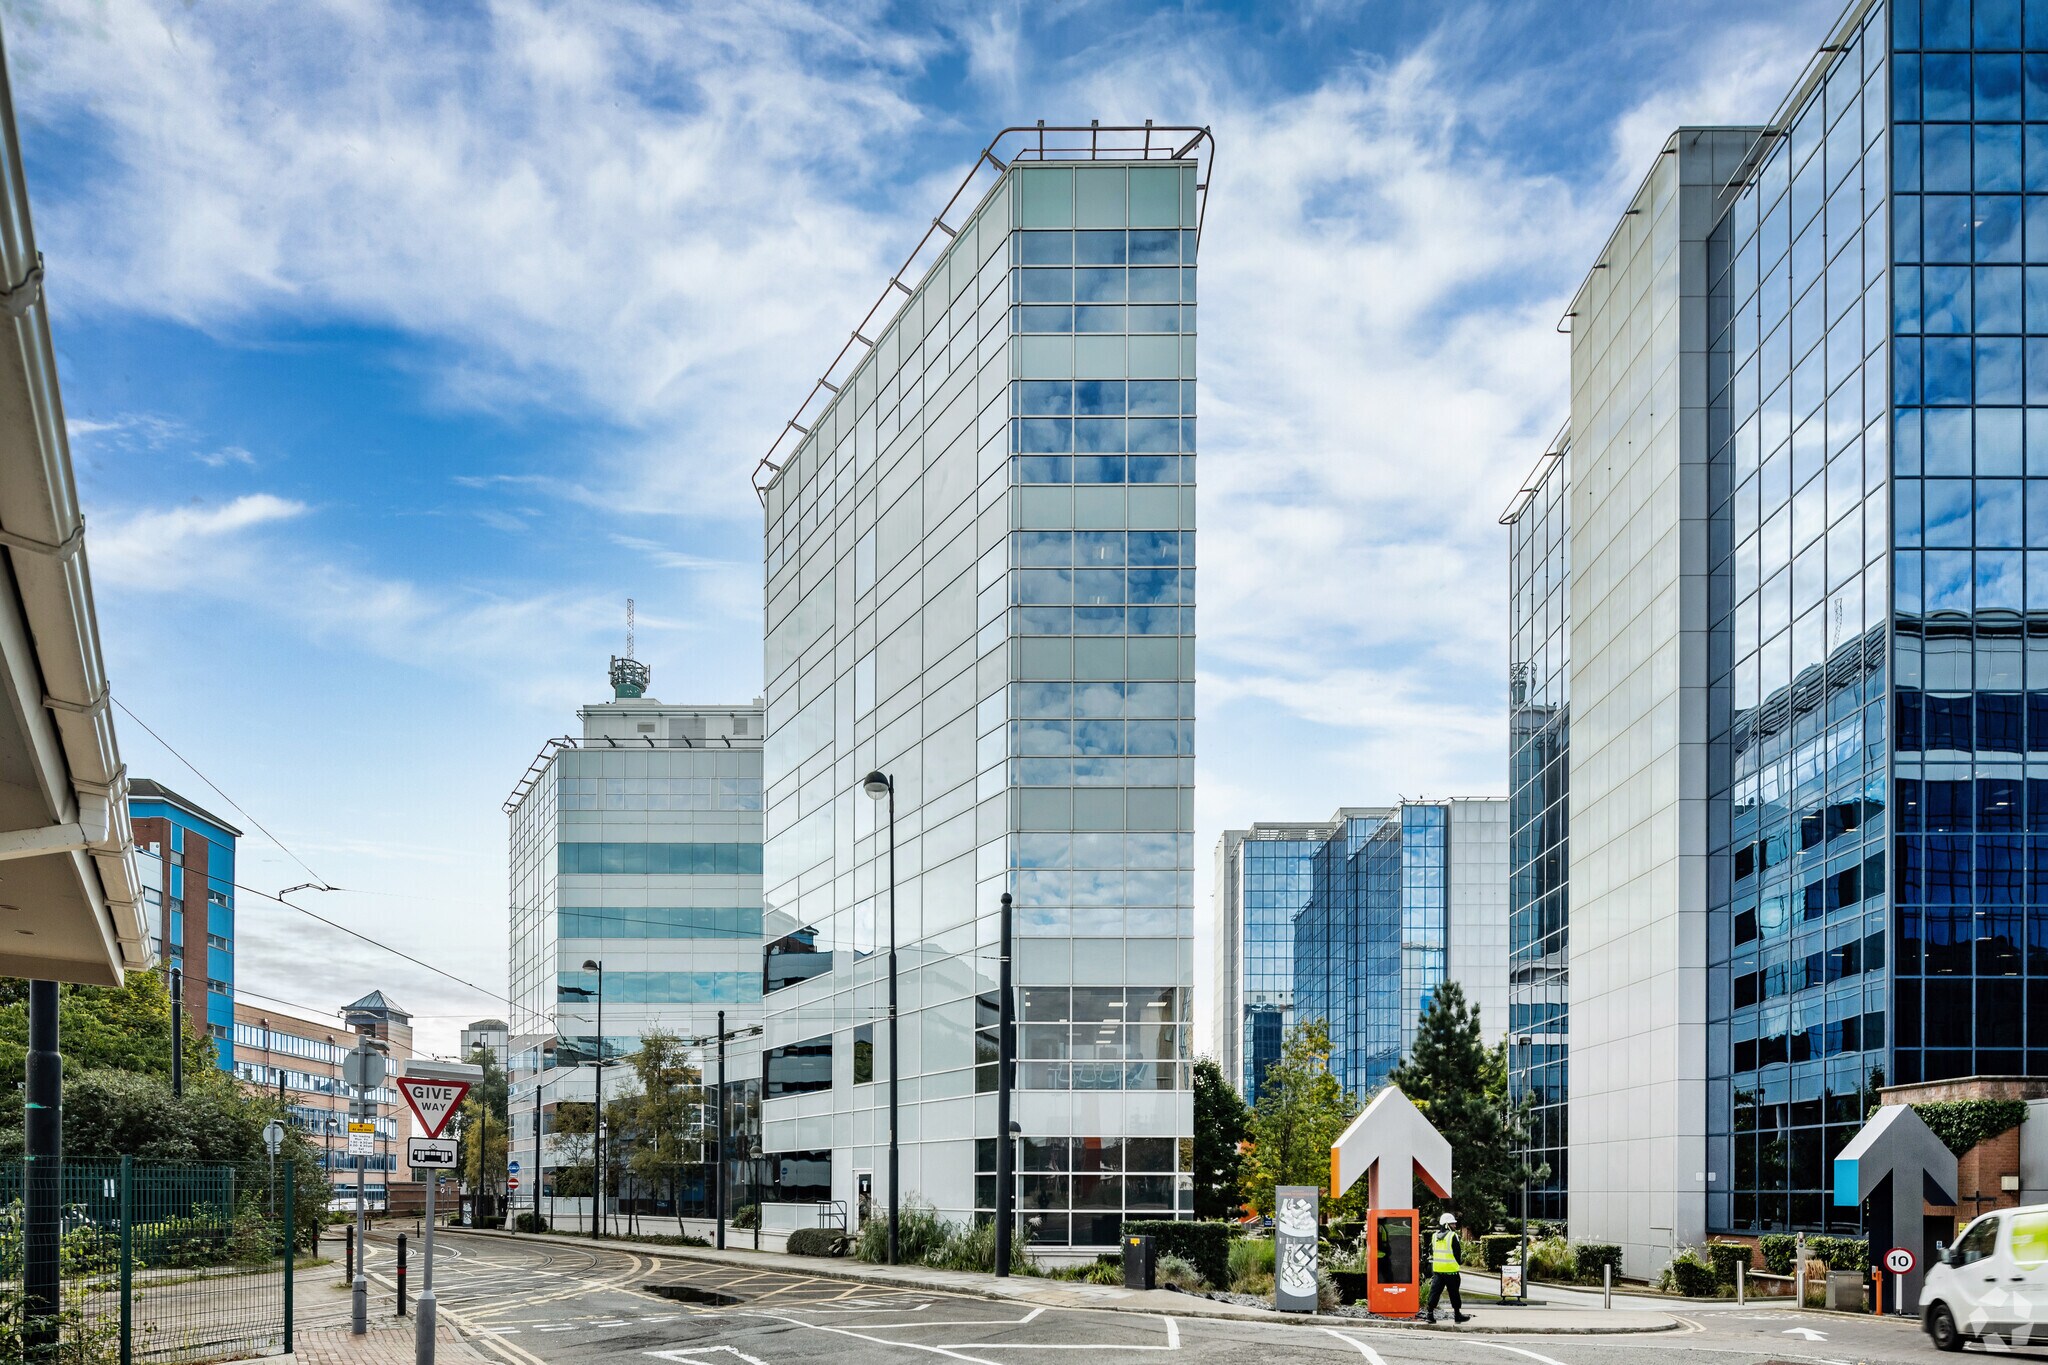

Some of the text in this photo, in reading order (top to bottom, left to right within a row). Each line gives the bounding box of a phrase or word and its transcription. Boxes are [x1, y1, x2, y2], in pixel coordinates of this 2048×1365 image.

[413, 1086, 452, 1100] GIVE
[421, 1102, 446, 1111] WAY
[1891, 1256, 1908, 1266] 10
